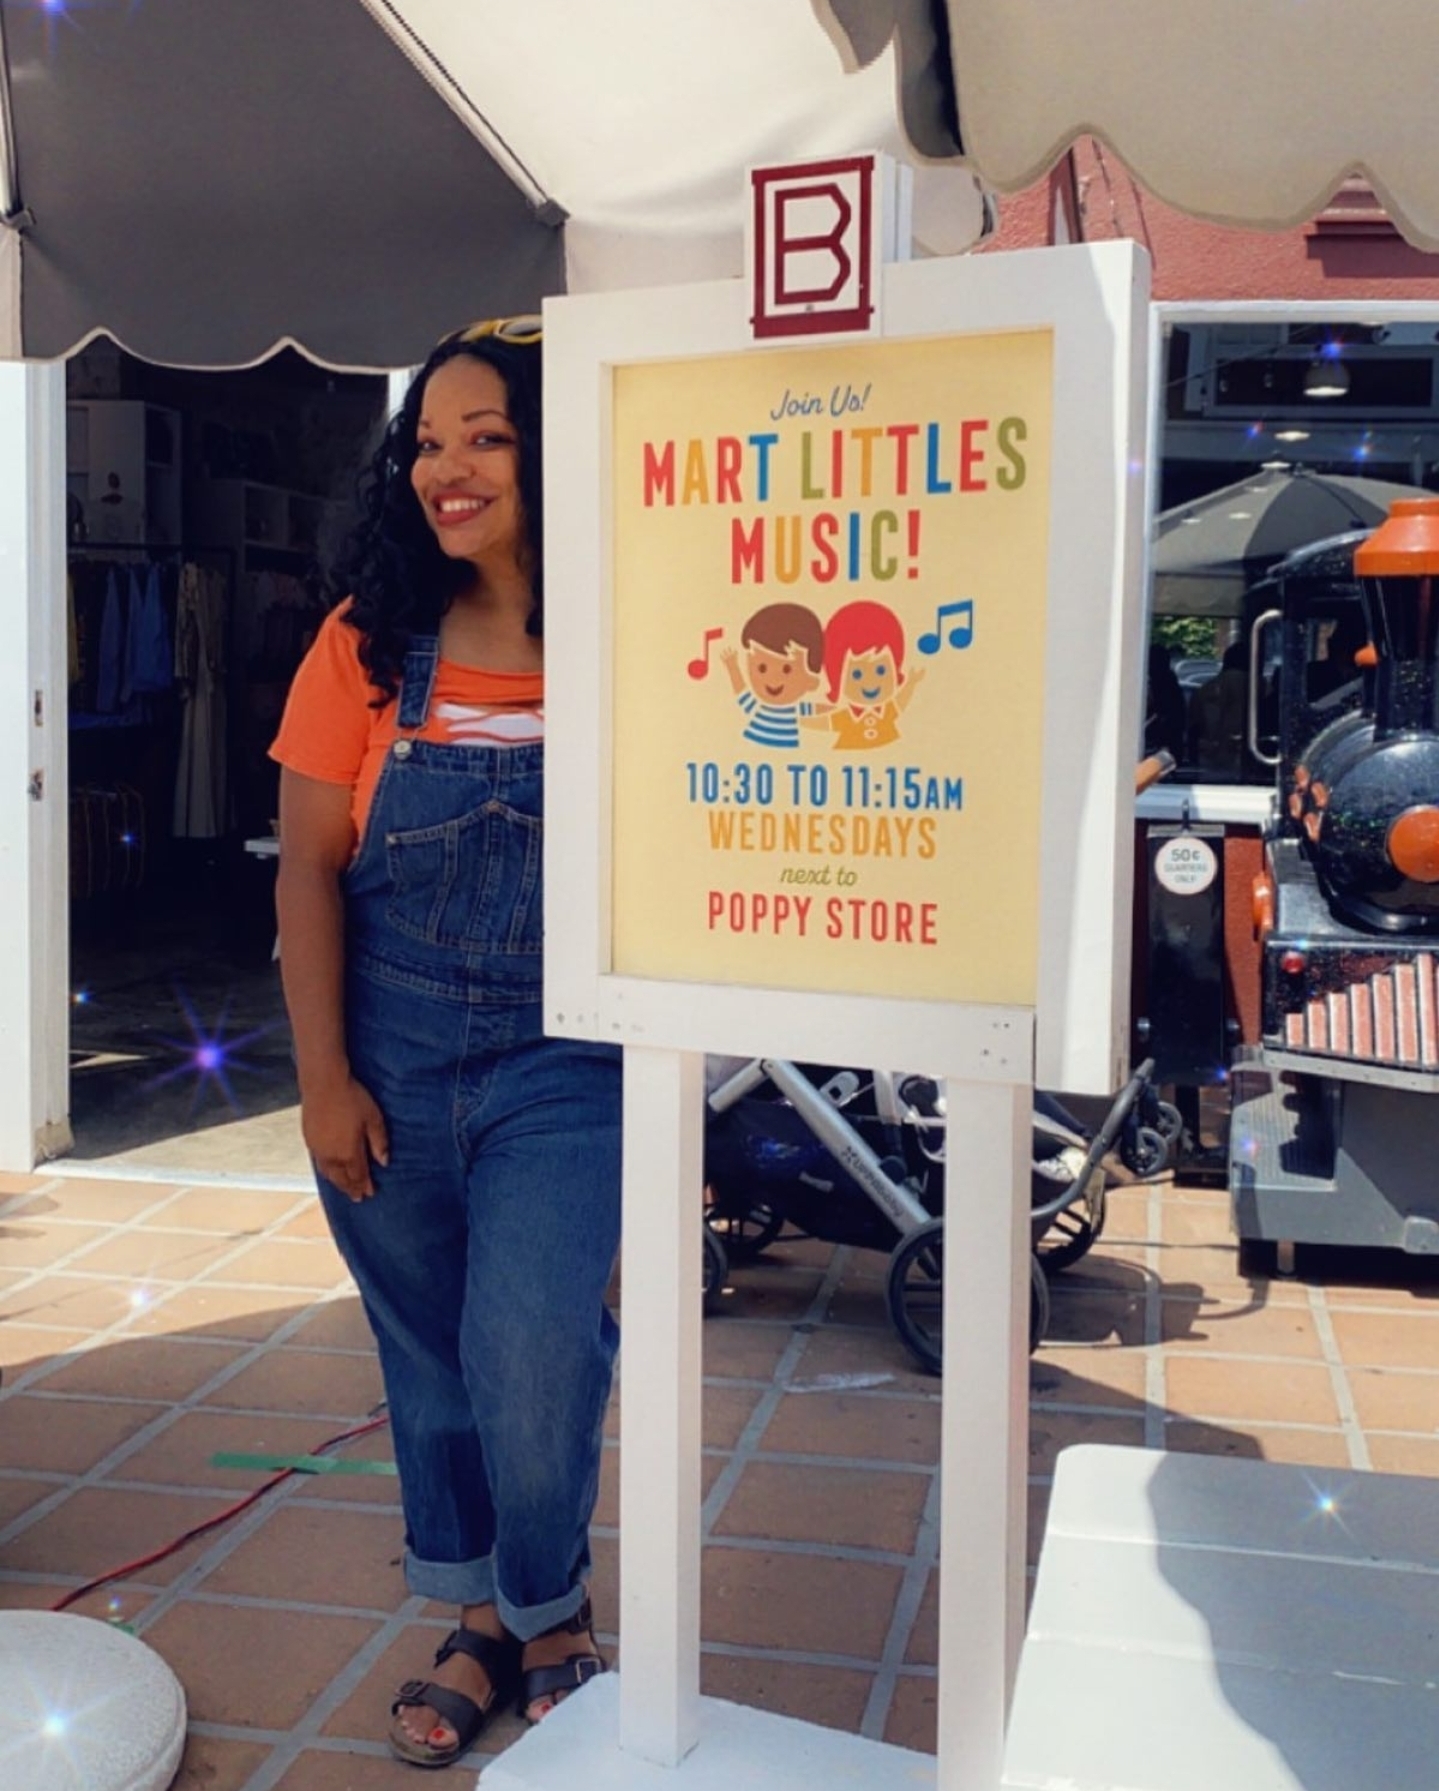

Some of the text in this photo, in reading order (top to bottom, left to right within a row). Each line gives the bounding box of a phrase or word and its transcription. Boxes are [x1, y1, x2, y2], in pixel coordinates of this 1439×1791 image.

[774, 182, 851, 306] B
[770, 383, 872, 420] Join Us!
[643, 416, 1028, 507] MART LITTLES
[731, 510, 921, 584] MUSIC!
[687, 762, 963, 811] 10:30 TO 11:15AM
[708, 810, 937, 860] WEDNESDAYS
[780, 864, 858, 887] next to
[709, 890, 938, 946] POPPY STORE
